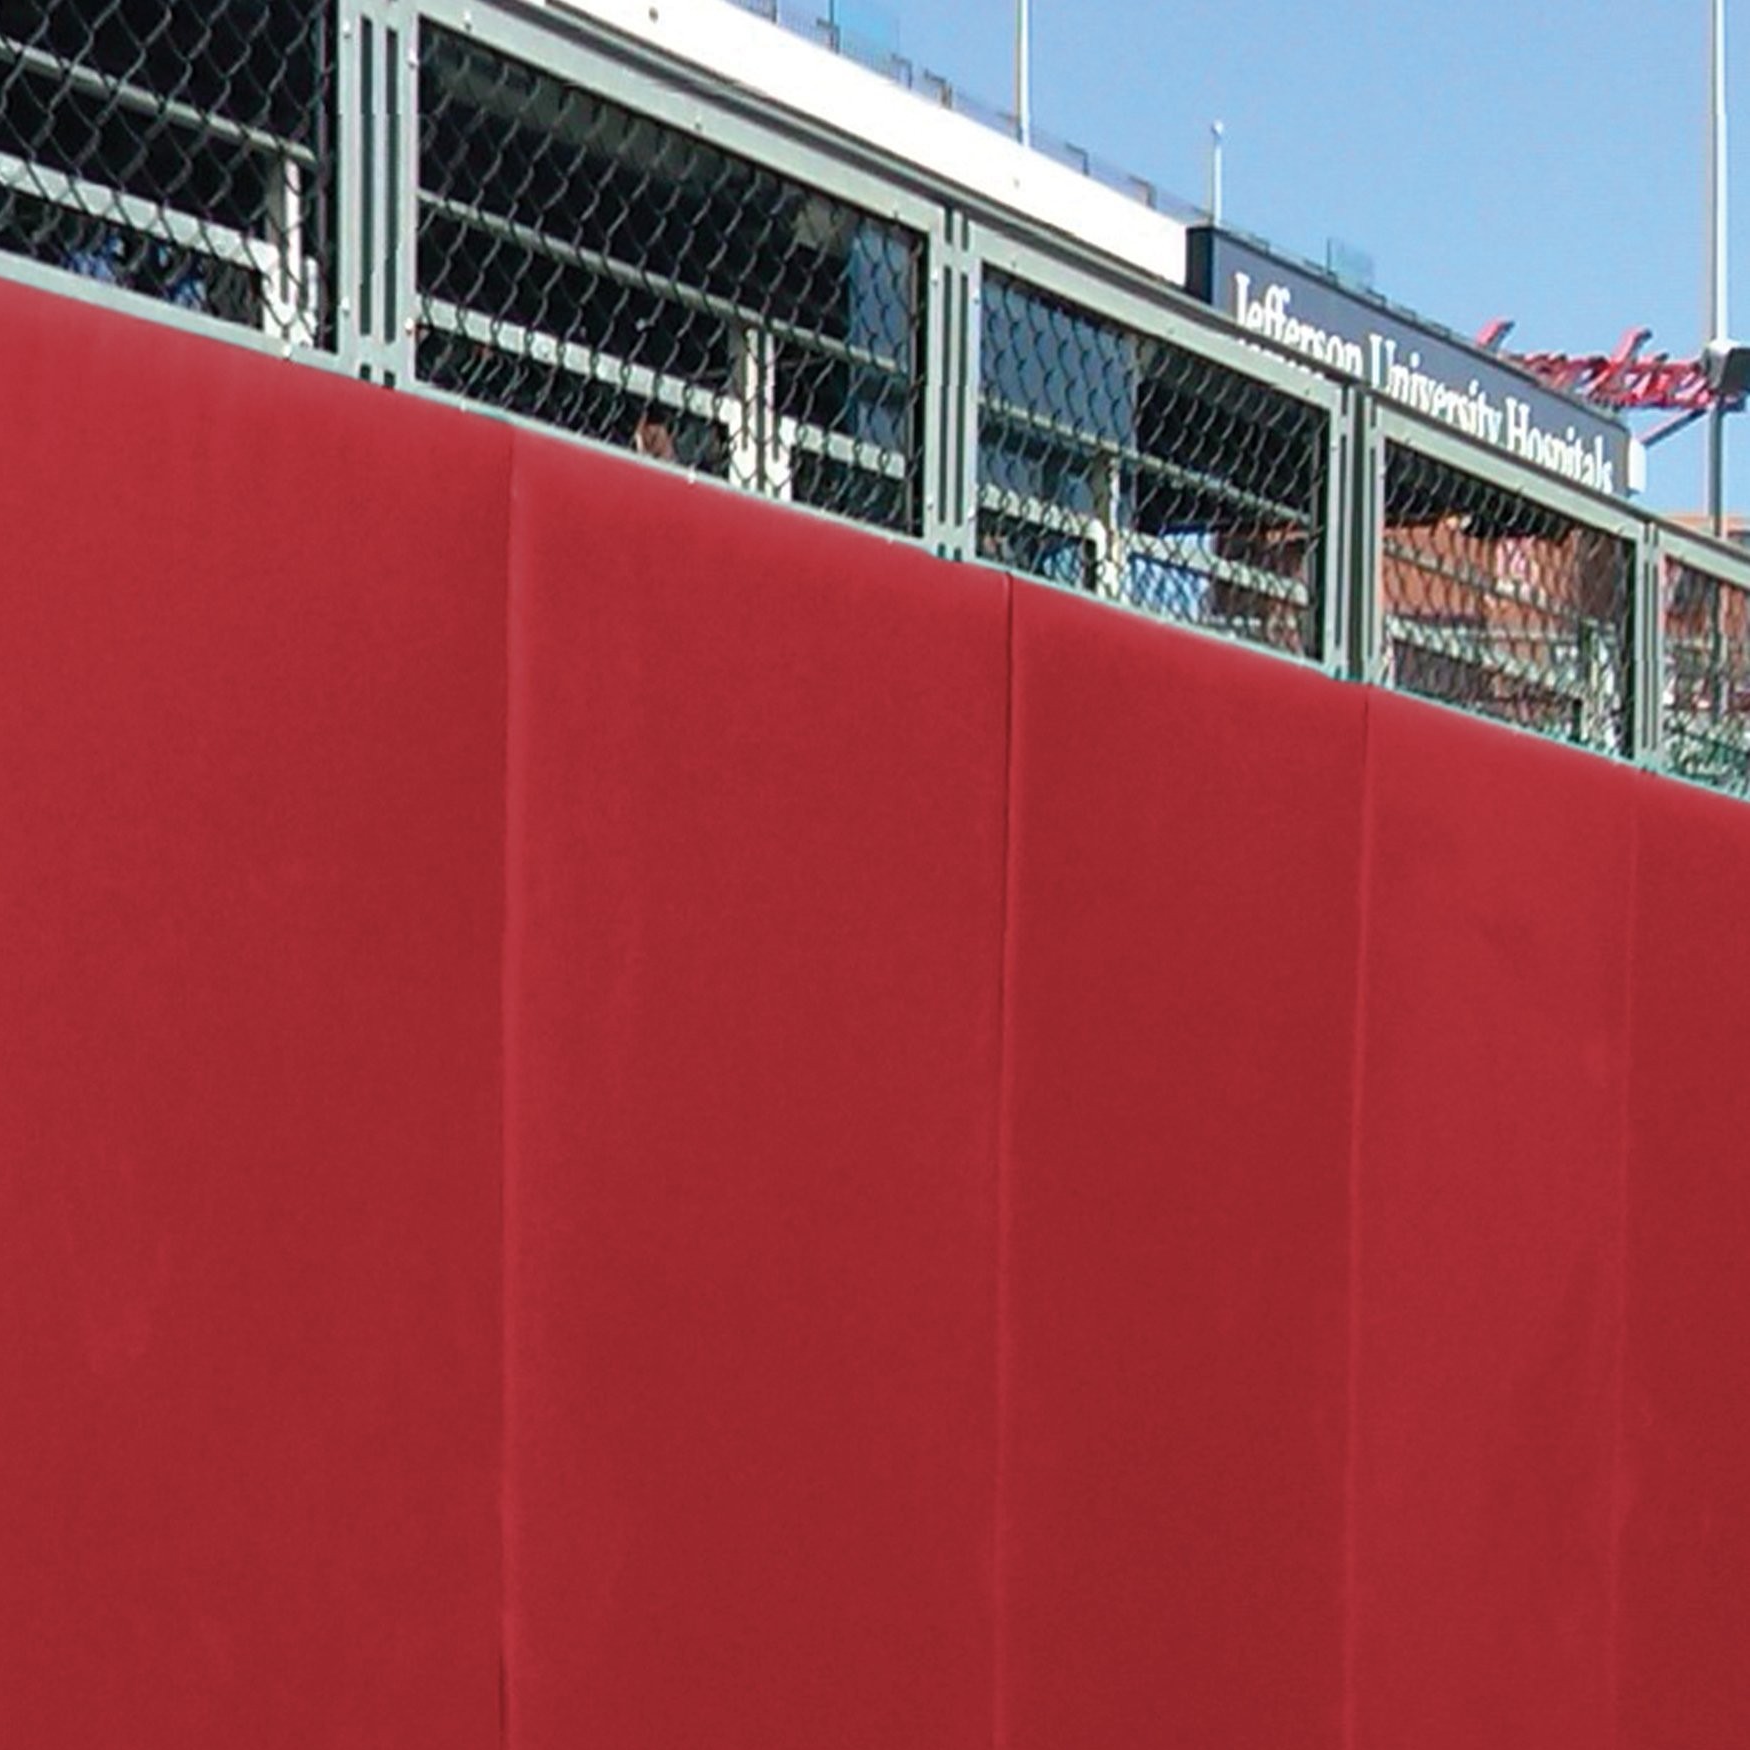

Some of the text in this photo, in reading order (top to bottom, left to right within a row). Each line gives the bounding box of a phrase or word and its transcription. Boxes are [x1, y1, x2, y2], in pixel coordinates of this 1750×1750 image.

[1235, 272, 1613, 494] Jefferson University Hospitals
